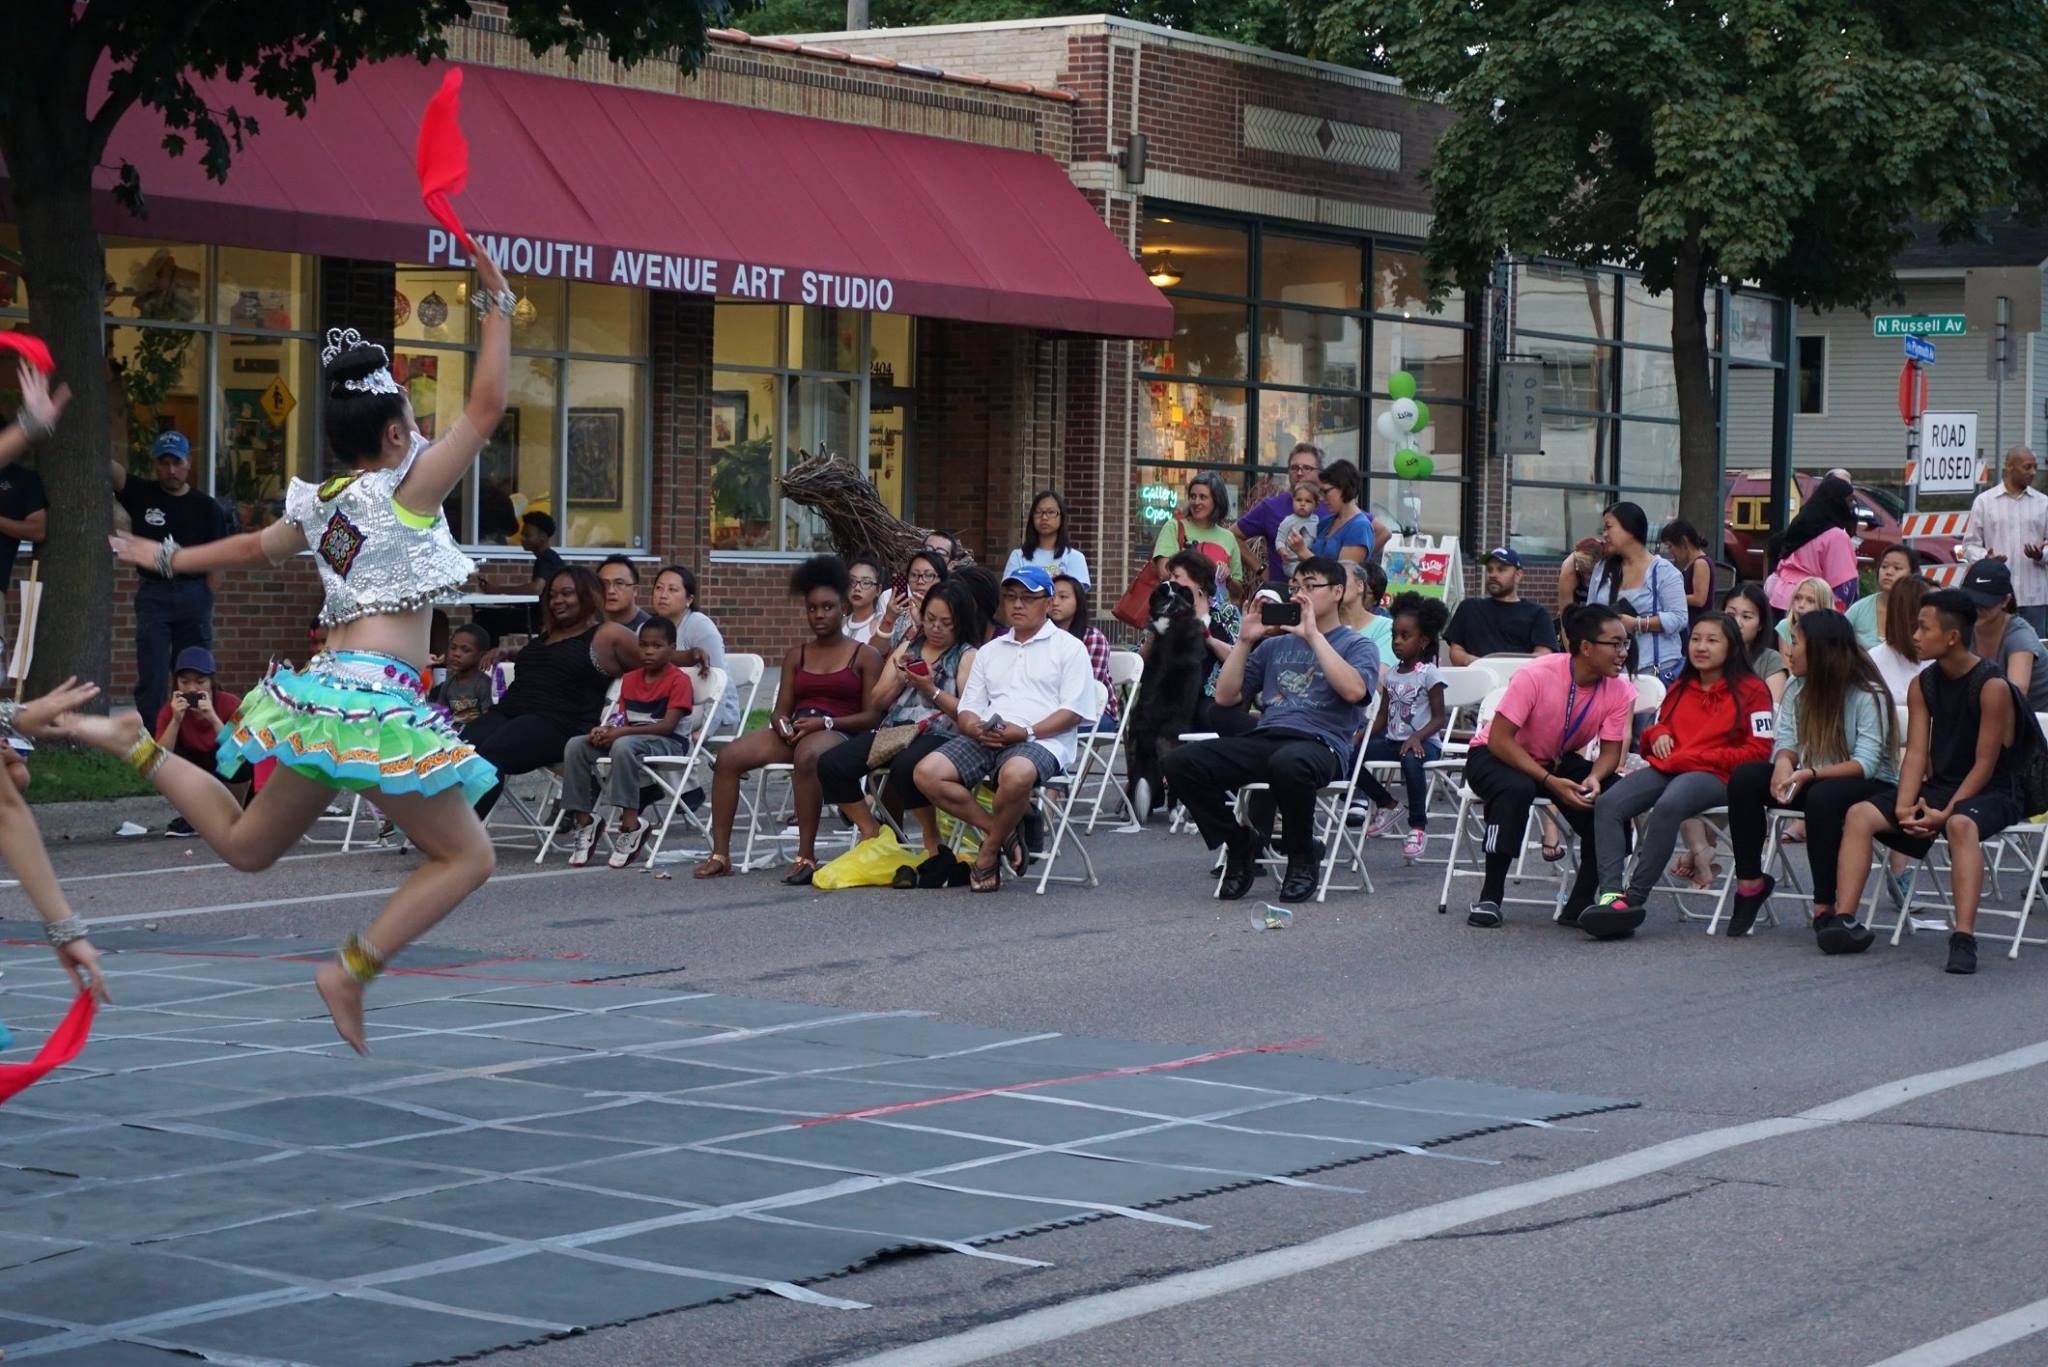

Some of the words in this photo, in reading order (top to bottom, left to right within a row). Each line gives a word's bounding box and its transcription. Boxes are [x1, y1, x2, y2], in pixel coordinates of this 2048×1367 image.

[610, 250, 718, 293] AVENUE
[730, 263, 785, 300] ART
[801, 270, 894, 312] STUDIO
[1878, 319, 1887, 332] N
[1891, 319, 1940, 332] Russell
[1945, 319, 1962, 332] Av
[1932, 424, 1966, 447] ROAD
[1924, 457, 1972, 480] CLOSED
[1142, 486, 1178, 508] Gallery
[1145, 506, 1173, 525] Open
